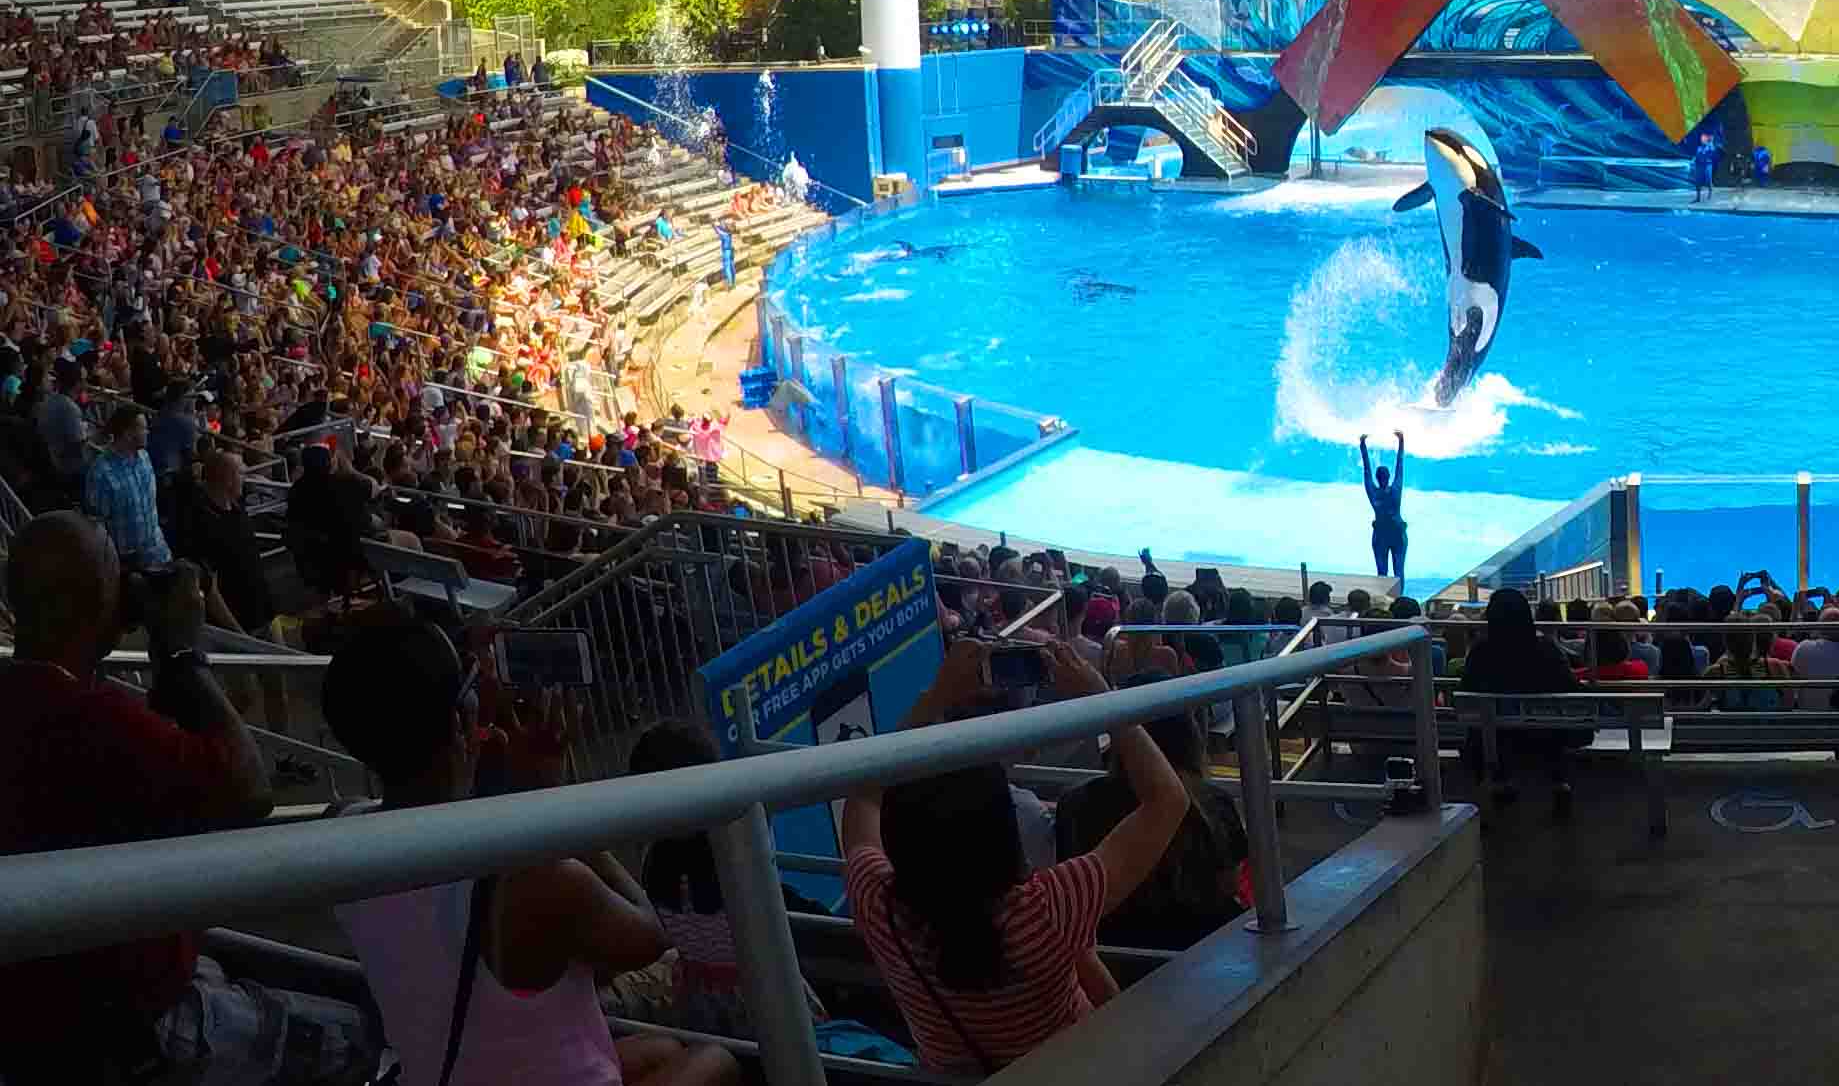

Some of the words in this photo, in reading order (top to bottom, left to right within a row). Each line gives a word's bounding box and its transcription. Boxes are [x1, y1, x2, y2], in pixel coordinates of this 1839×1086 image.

[834, 614, 850, 644] &
[853, 564, 926, 627] DEALS
[727, 703, 761, 743] OR
[762, 683, 801, 723] FREE
[801, 665, 832, 702] APP
[832, 639, 867, 671] GETS
[867, 618, 895, 648] YOU
[896, 596, 929, 627] BOTH
